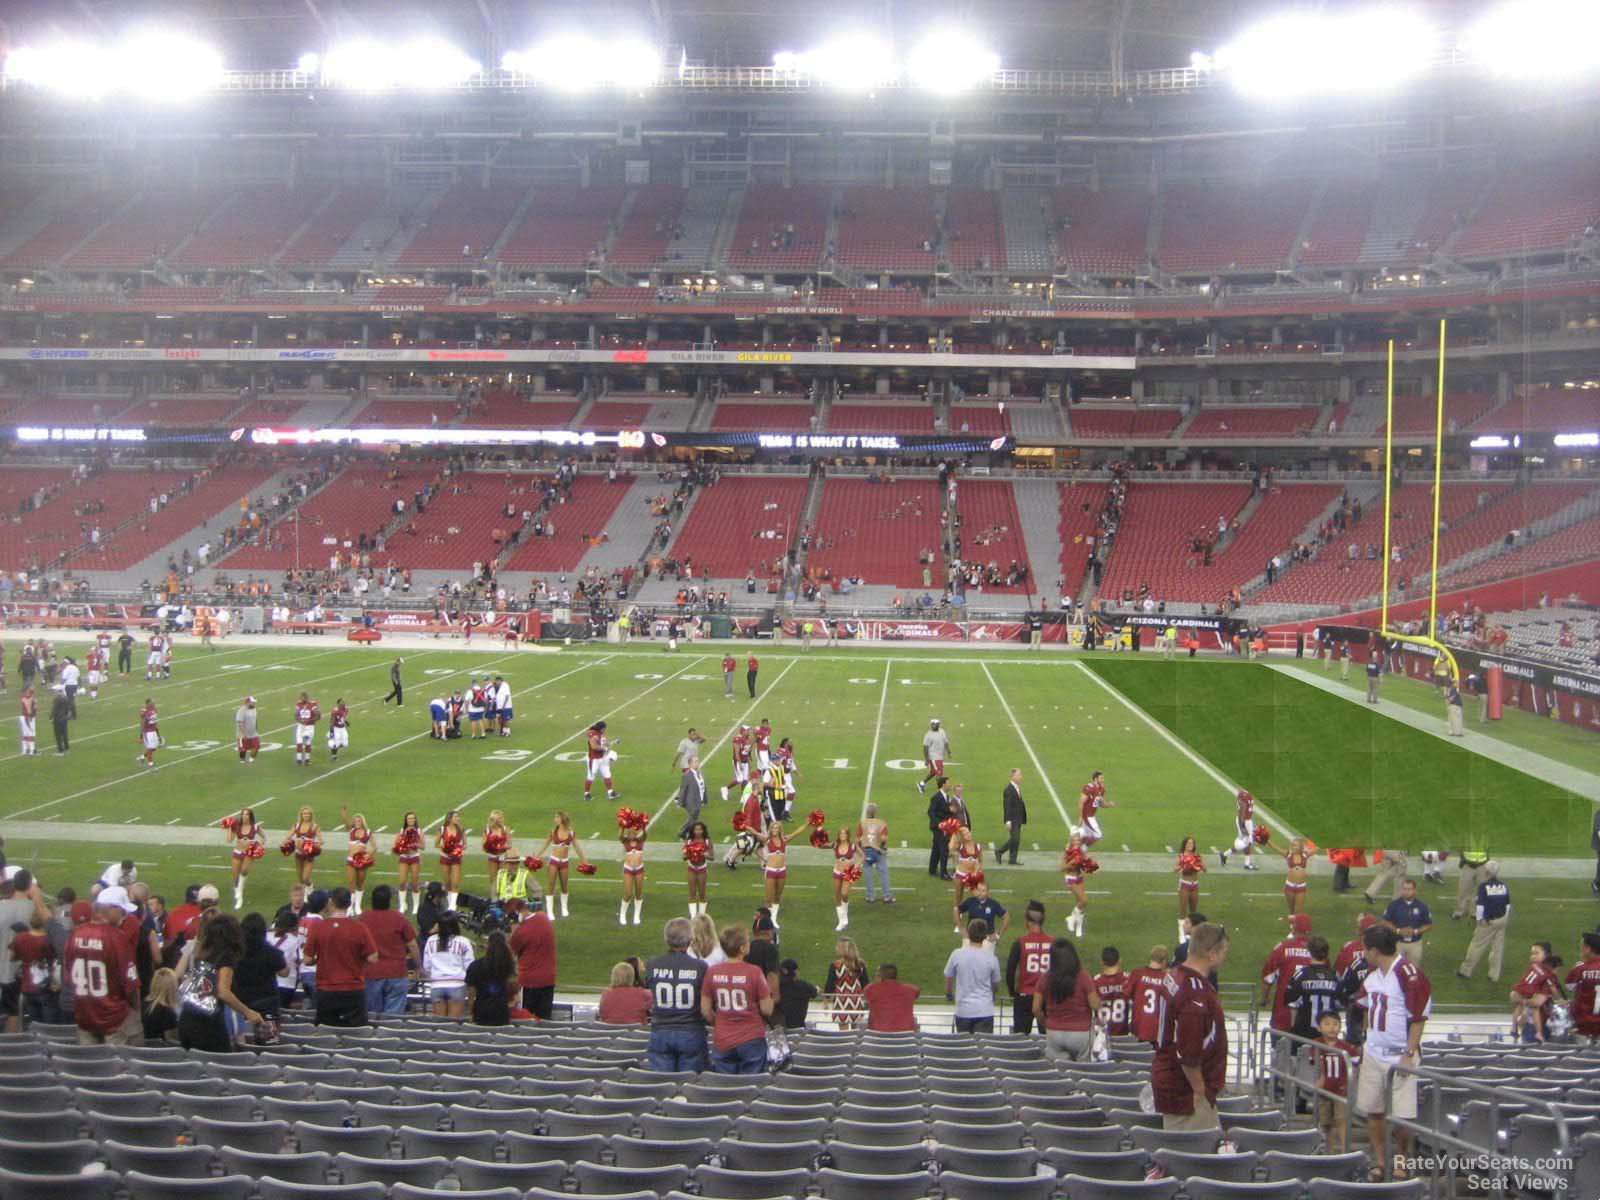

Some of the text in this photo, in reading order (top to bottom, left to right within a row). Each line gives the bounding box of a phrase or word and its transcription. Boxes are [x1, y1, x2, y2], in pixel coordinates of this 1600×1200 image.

[671, 353, 724, 361] GILA RIVER
[737, 353, 792, 361] GILA RIVER
[796, 436, 808, 447] IS
[809, 436, 844, 447] WHAT
[847, 437, 858, 447] IT
[1126, 617, 1219, 628] ARIZONA CARDINALS
[653, 967, 674, 979] PAPA
[1026, 952, 1051, 973] 69
[1401, 962, 1417, 977] 11
[71, 957, 109, 997] 40
[655, 982, 695, 1010] 00
[716, 987, 748, 1011] 00
[1143, 988, 1156, 1014] 3
[1098, 999, 1126, 1023] 68
[1370, 991, 1389, 1033] 11
[1325, 1055, 1340, 1079] 11
